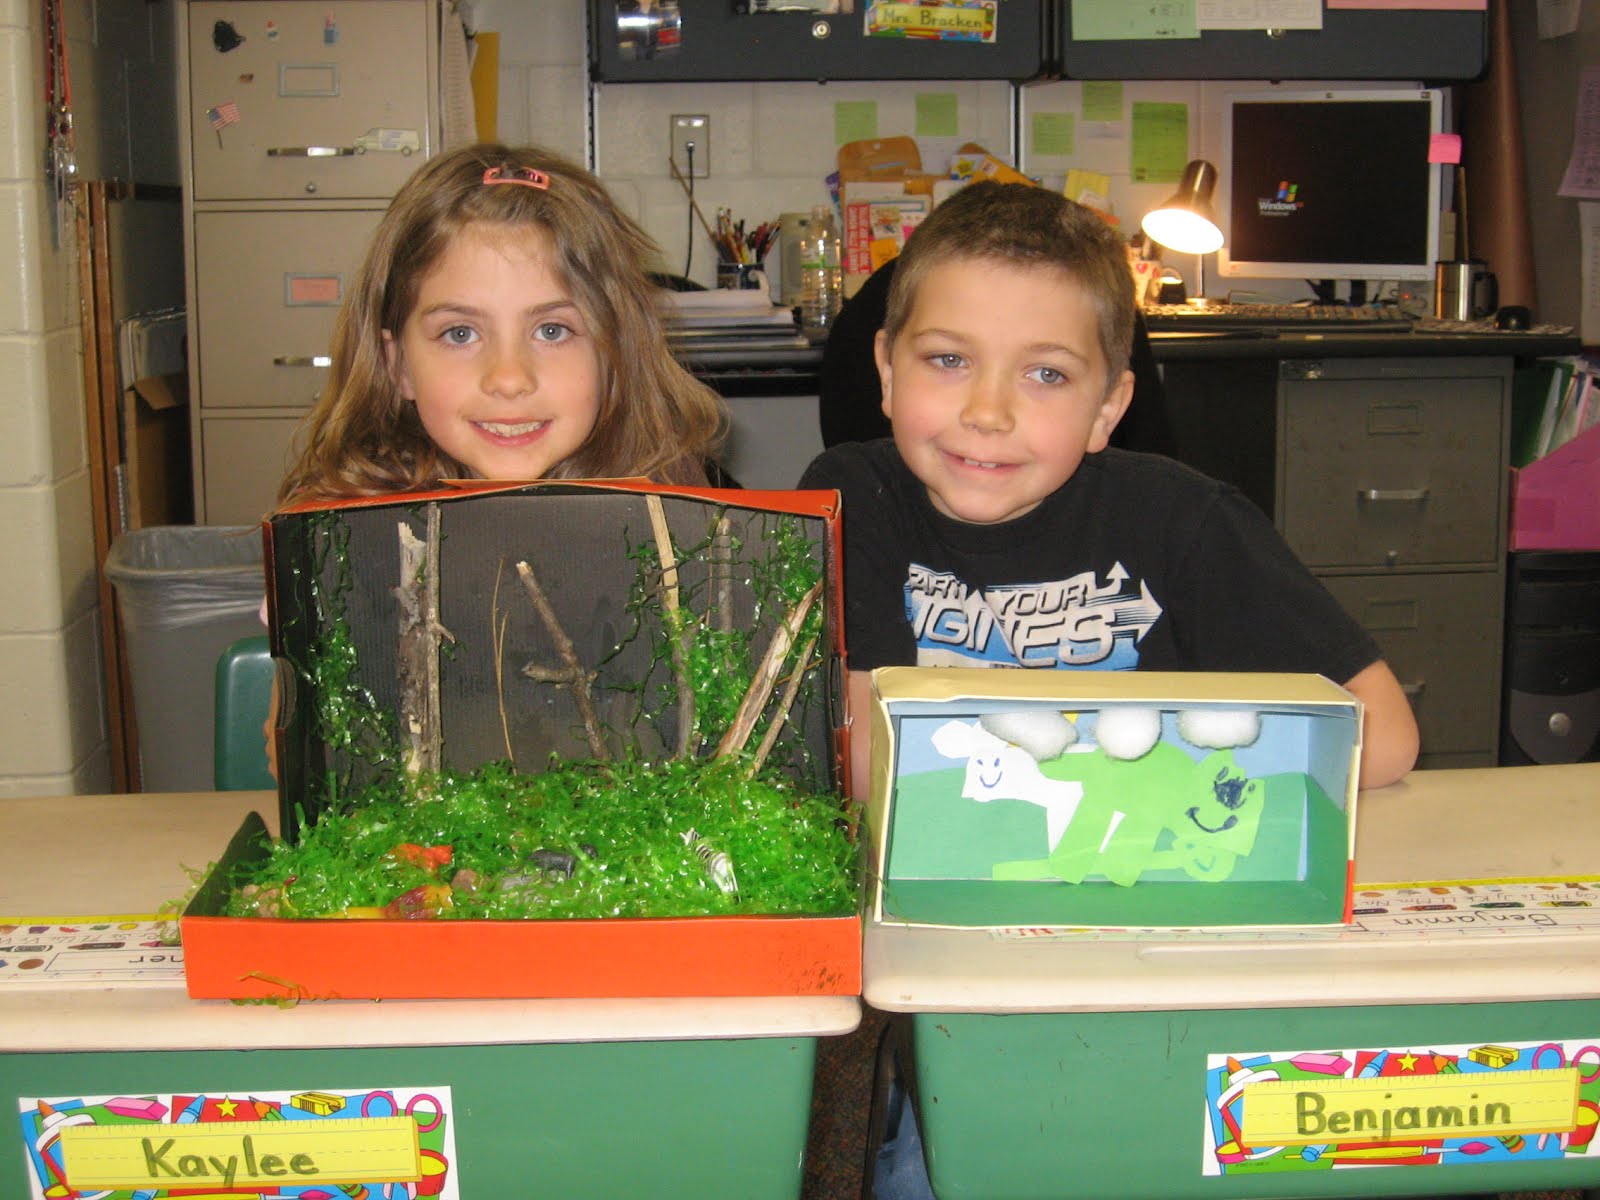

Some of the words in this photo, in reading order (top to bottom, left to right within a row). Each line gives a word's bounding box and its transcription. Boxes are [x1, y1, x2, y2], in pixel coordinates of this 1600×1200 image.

[883, 8, 912, 25] Mrs.
[920, 9, 982, 28] Bracken
[1258, 200, 1297, 211] Windows
[995, 582, 1088, 616] YOUR
[1393, 910, 1558, 926] Benjamin
[1295, 1091, 1511, 1142] Benjamin
[141, 1134, 320, 1188] Kaylee
